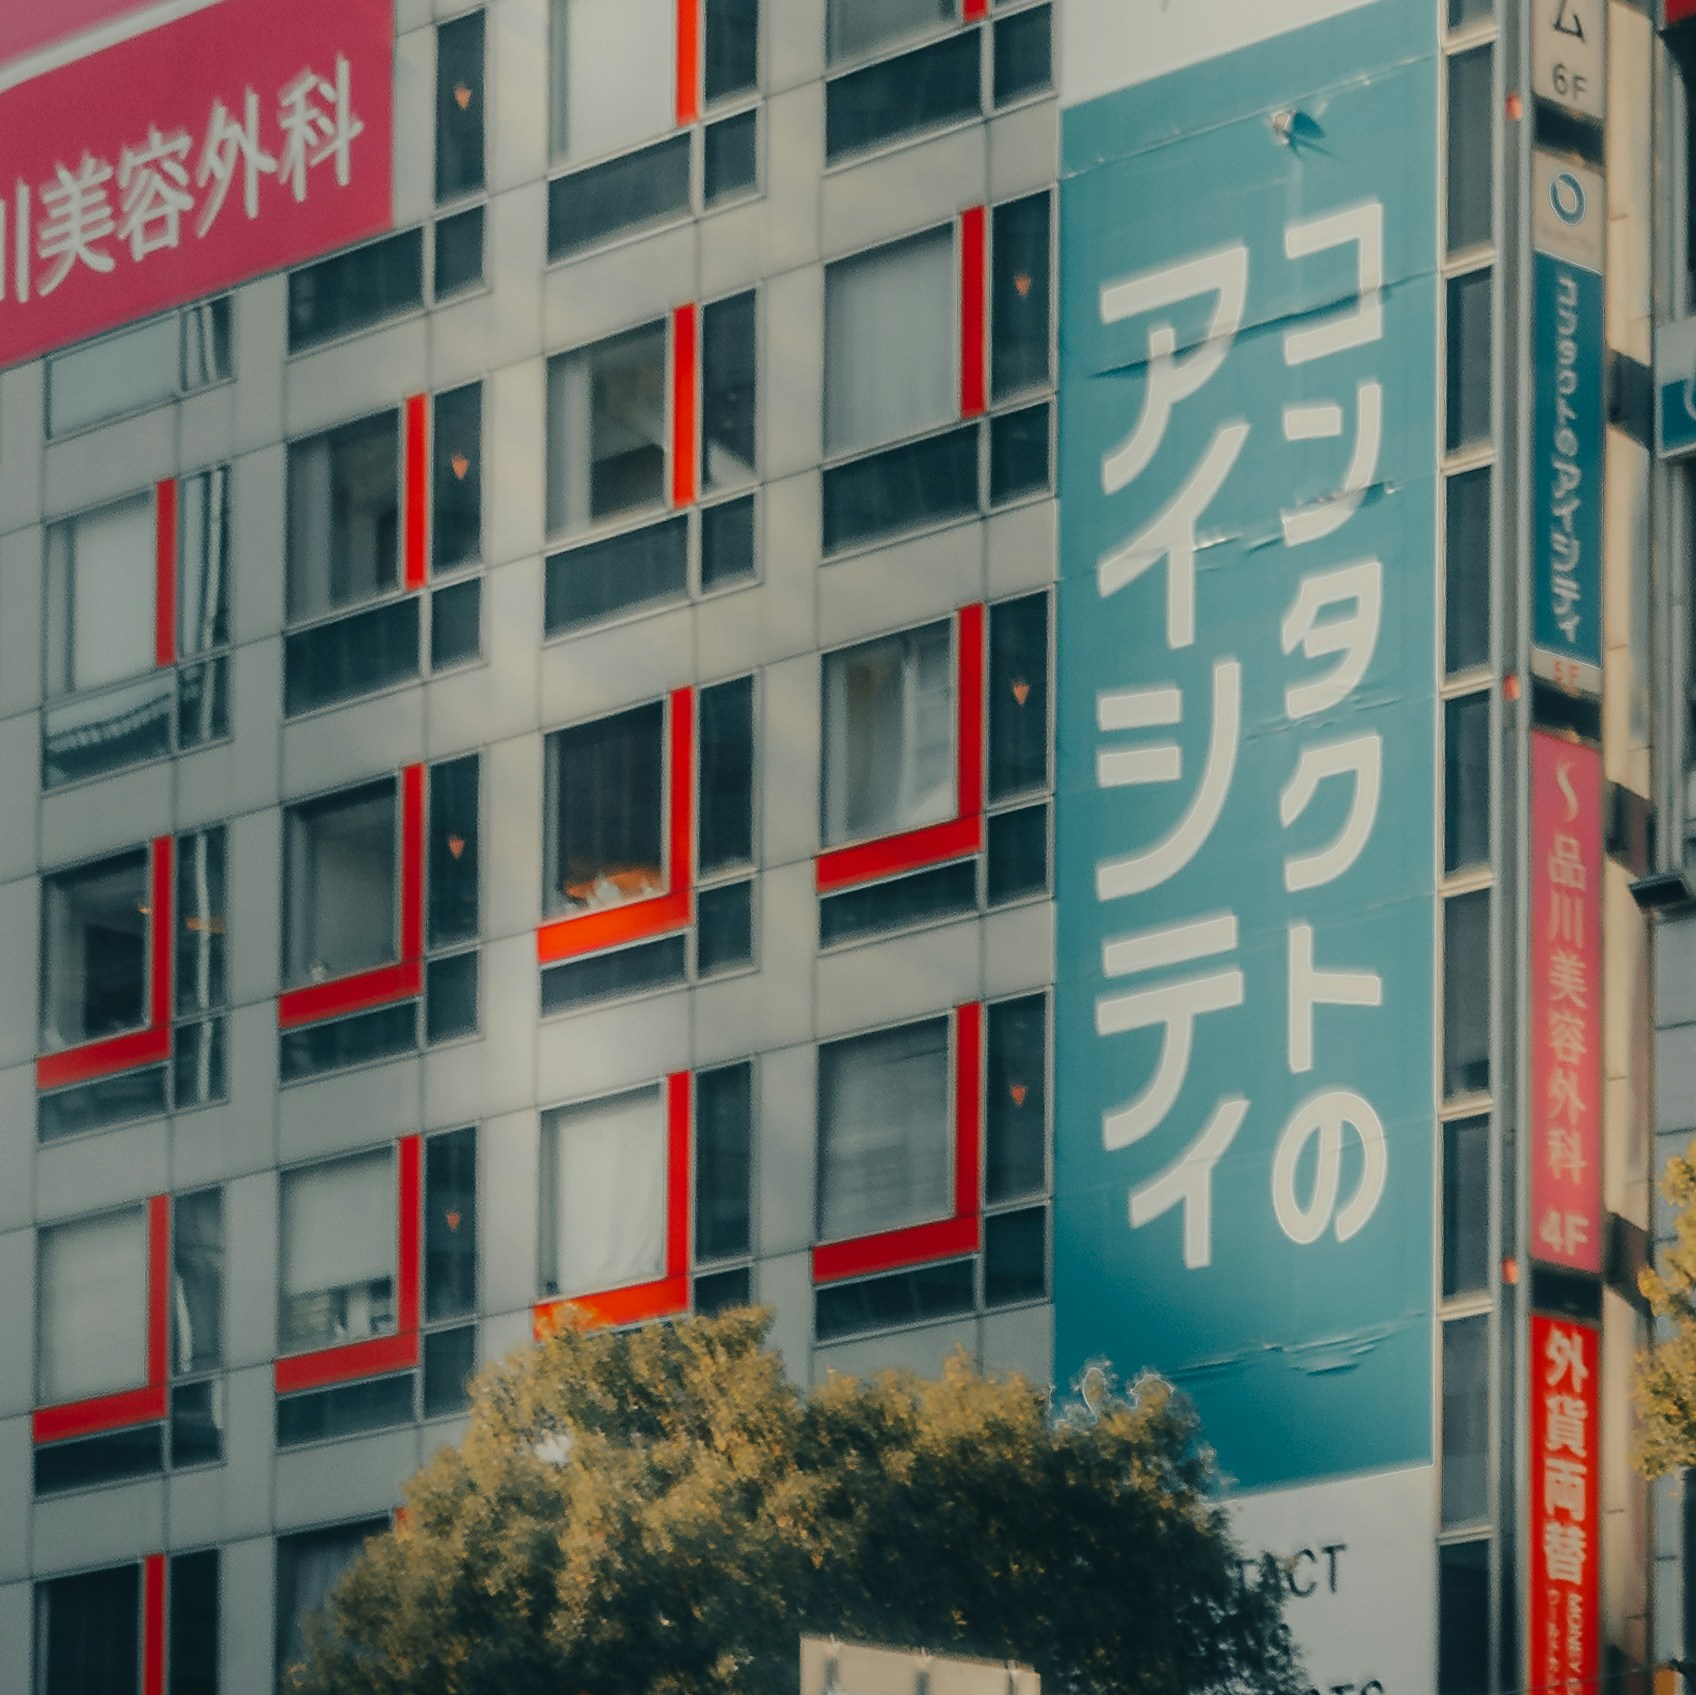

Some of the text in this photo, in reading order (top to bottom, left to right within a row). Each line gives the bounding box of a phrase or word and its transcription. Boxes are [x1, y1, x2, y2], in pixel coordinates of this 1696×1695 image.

[1552, 62, 1589, 99] 6F
[1096, 243, 1251, 1270] アイシティ
[1272, 202, 1389, 1245] コンタクトの
[1539, 832, 1590, 1257] 品川美容外科 4F
[1567, 1592, 1583, 1674] MONEY
